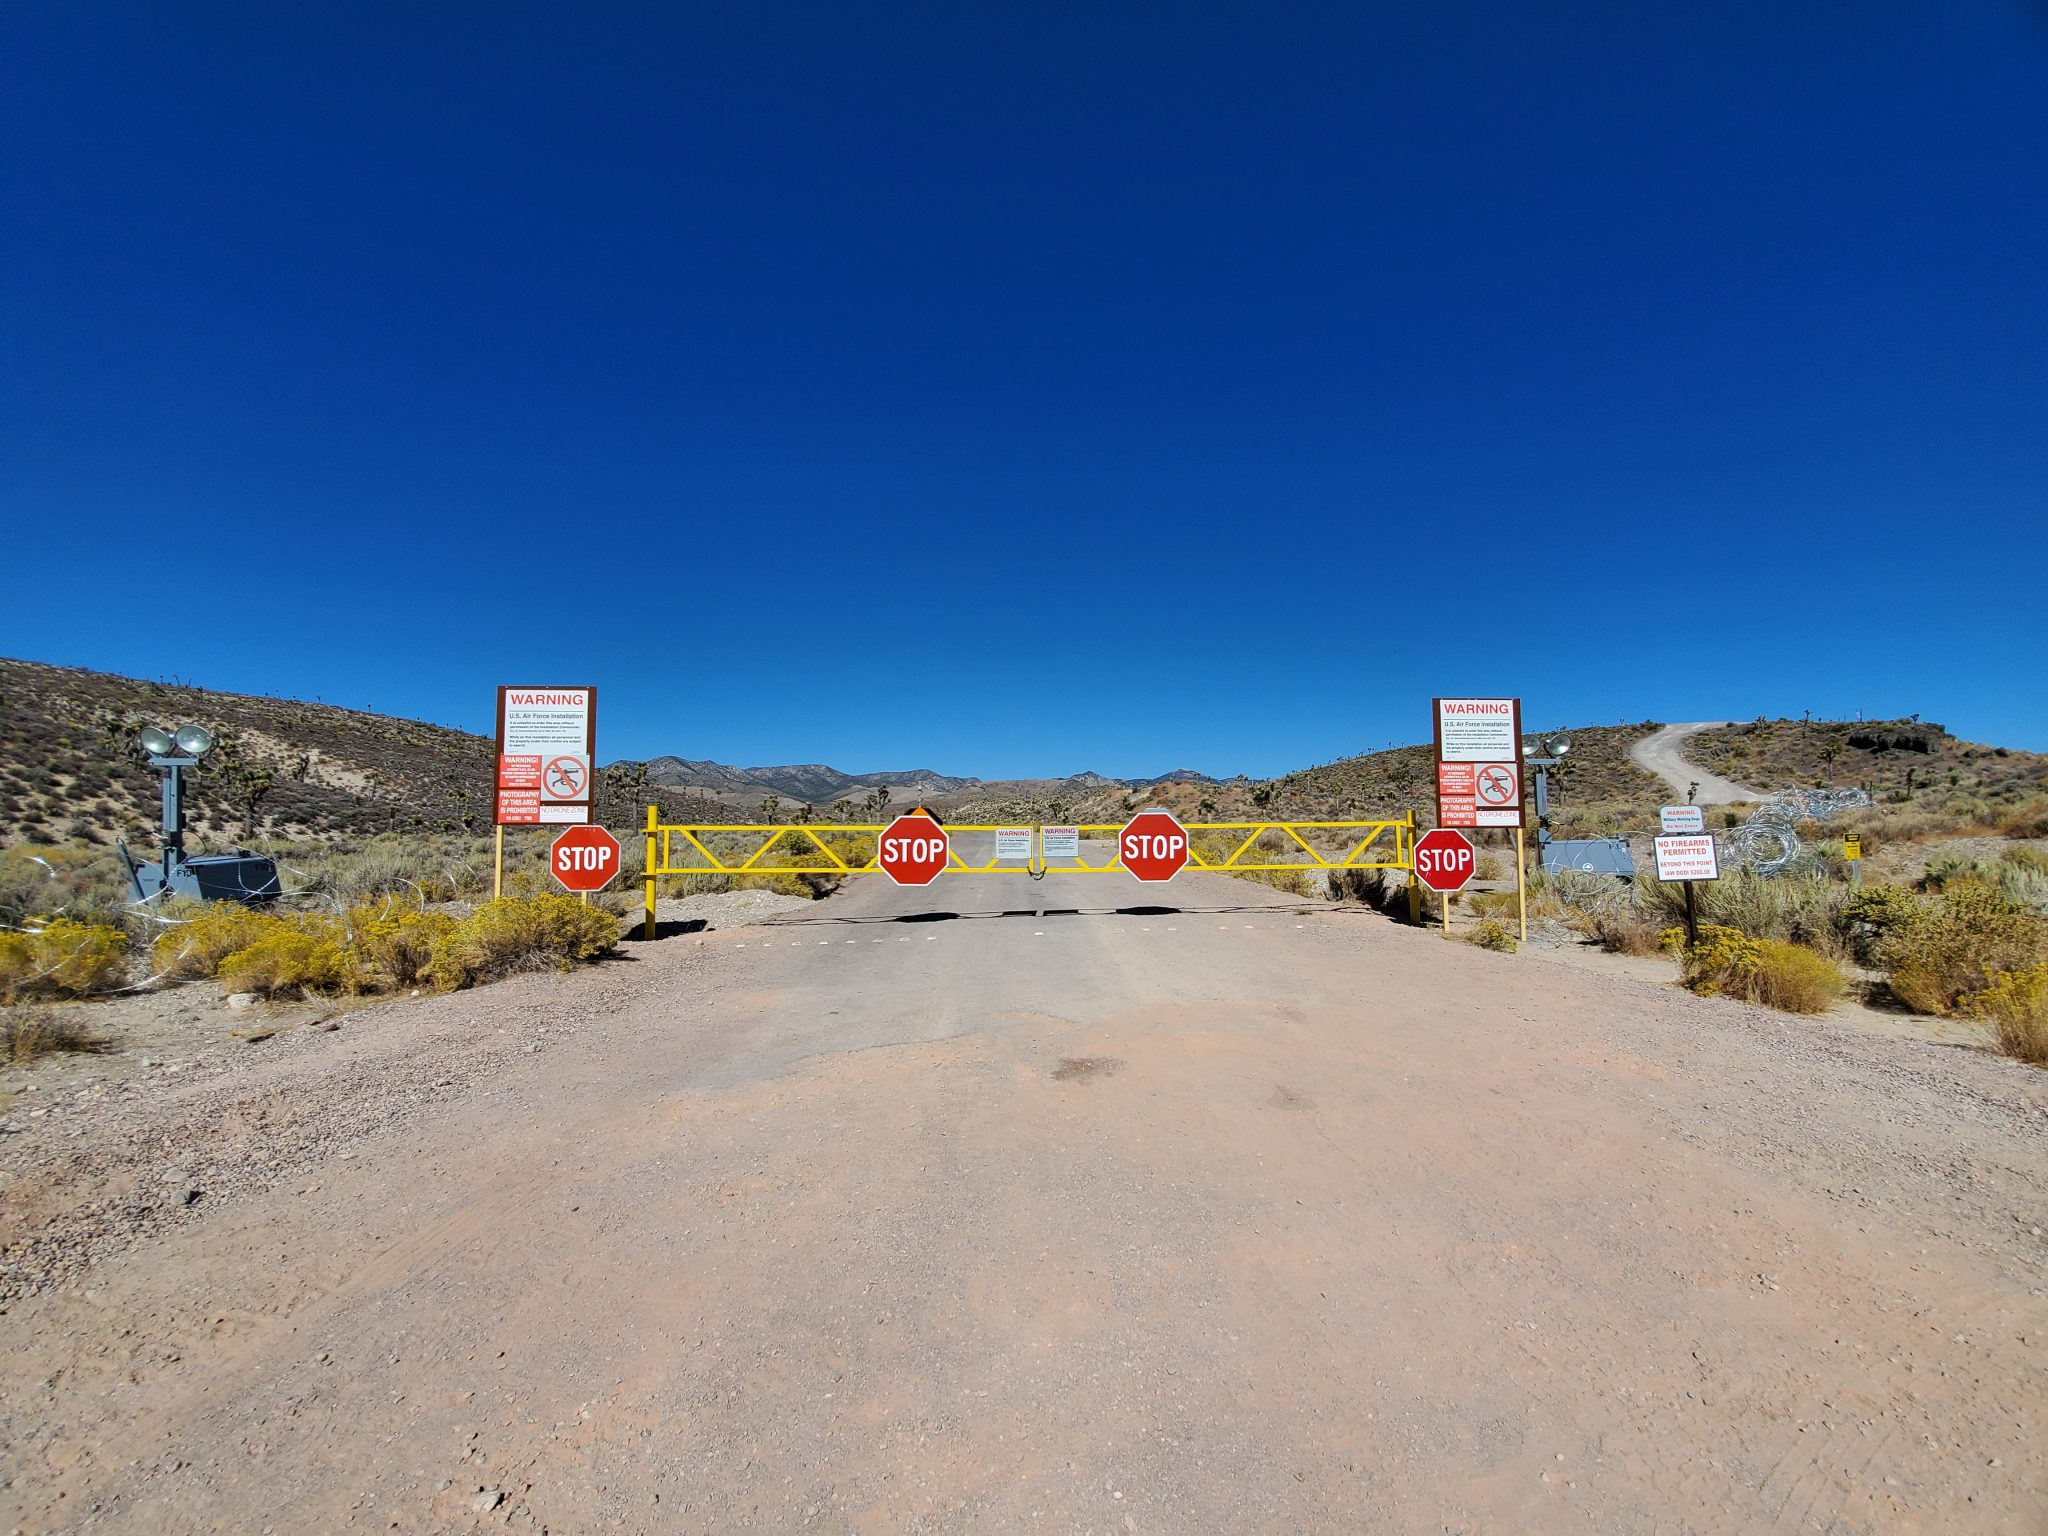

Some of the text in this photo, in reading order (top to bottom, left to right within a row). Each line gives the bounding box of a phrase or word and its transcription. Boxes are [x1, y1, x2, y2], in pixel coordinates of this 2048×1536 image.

[510, 694, 584, 705] WARNING
[1444, 704, 1508, 714] WARNING
[558, 846, 611, 870] STOP
[884, 838, 944, 863] STOP
[1125, 835, 1184, 859] STOP
[1419, 848, 1470, 872] STOP
